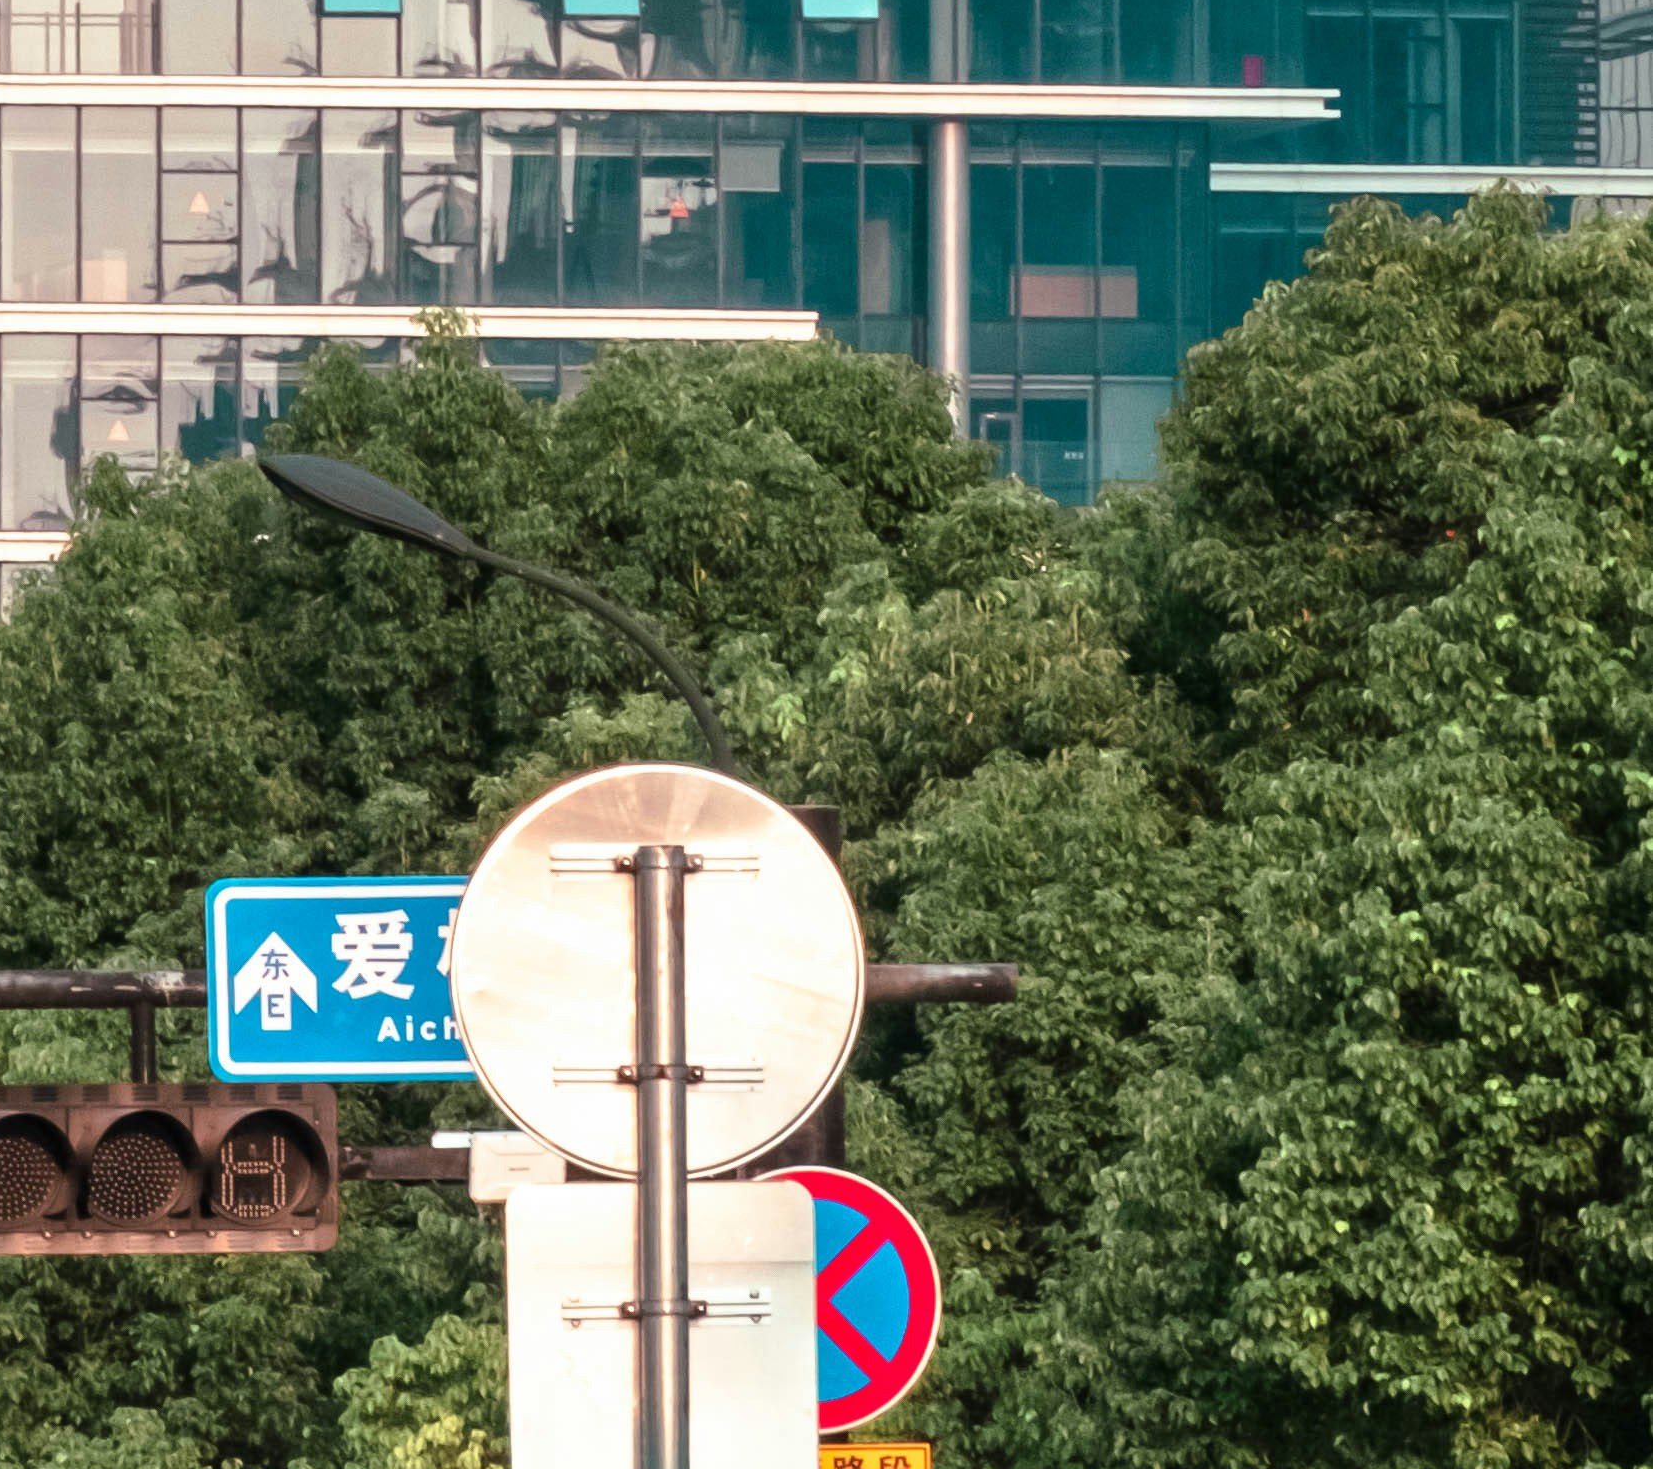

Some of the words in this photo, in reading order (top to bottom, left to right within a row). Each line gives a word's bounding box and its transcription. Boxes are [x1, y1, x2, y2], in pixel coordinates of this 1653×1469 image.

[261, 948, 290, 981] 东
[331, 908, 459, 1000] 爱
[267, 993, 285, 1018] E
